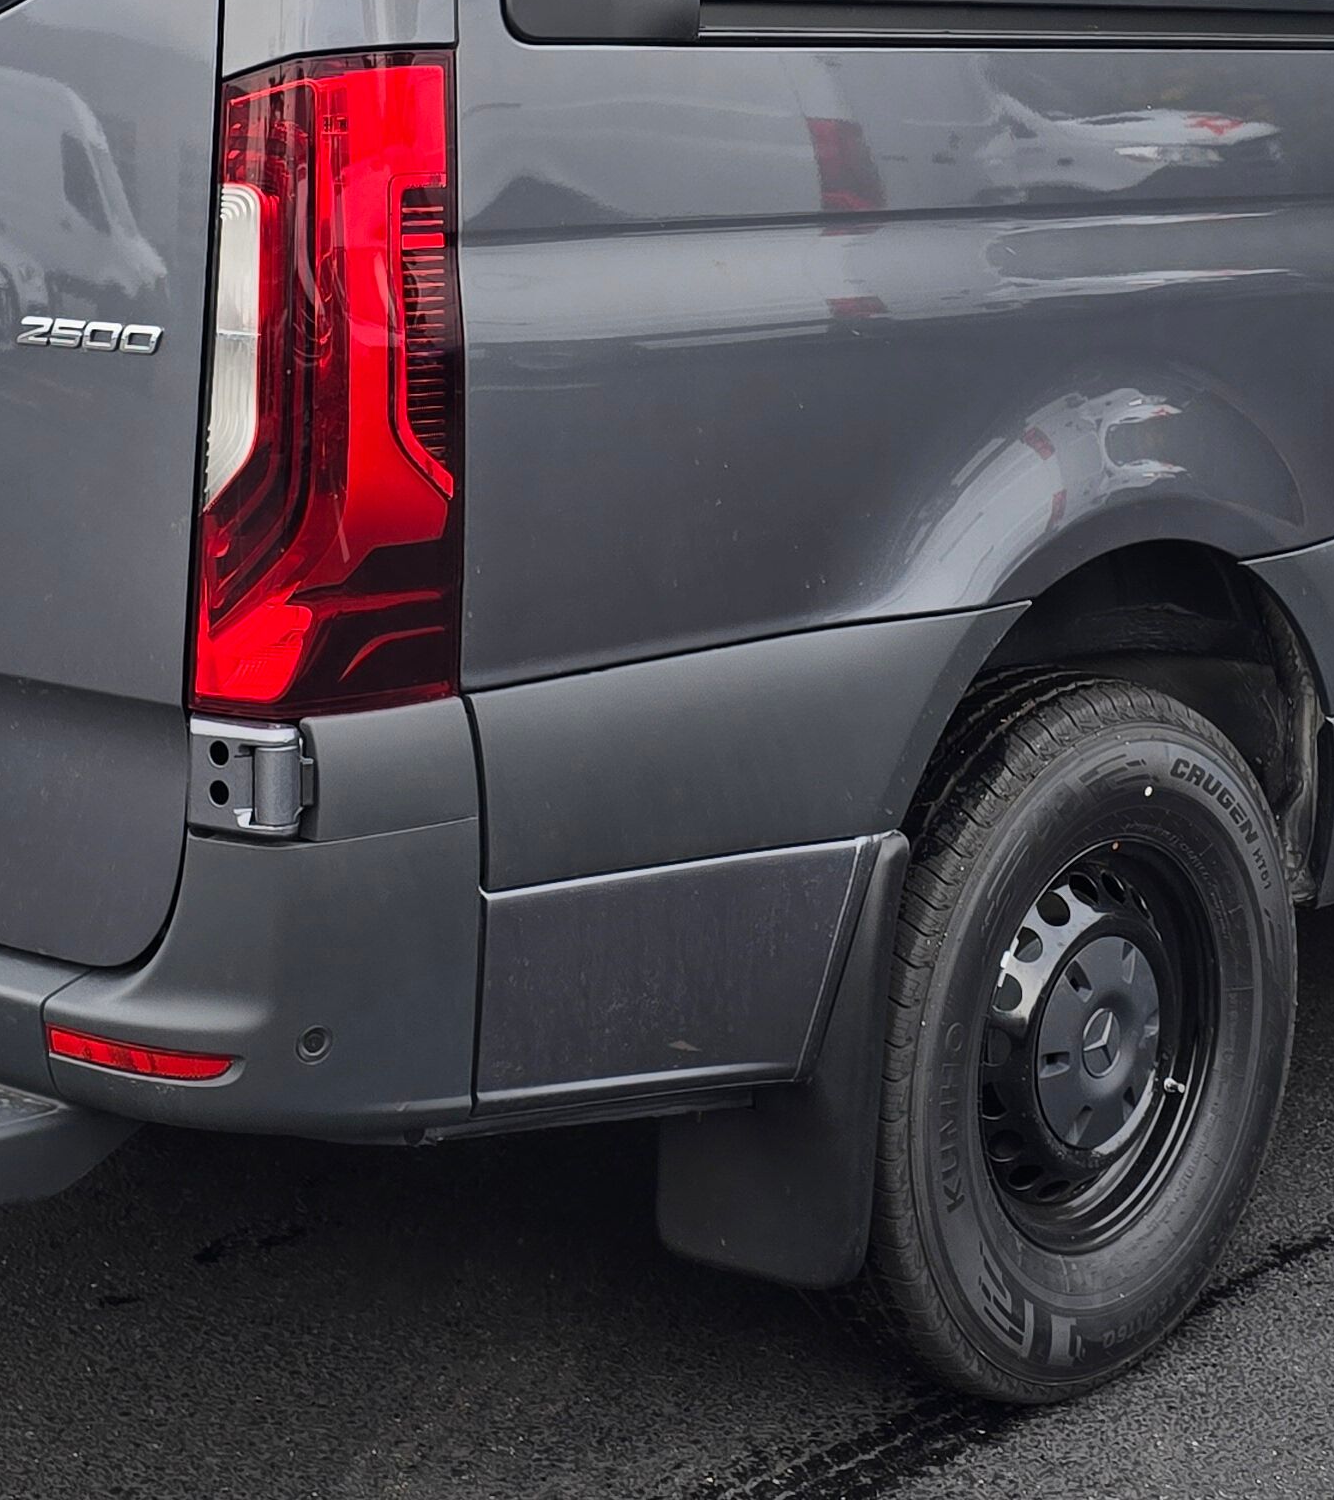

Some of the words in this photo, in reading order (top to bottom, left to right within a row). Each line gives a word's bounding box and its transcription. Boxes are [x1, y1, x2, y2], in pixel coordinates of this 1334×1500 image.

[16, 315, 164, 354] 2500
[1169, 757, 1260, 845] CRUGEN
[938, 1021, 966, 1214] KUMHO
